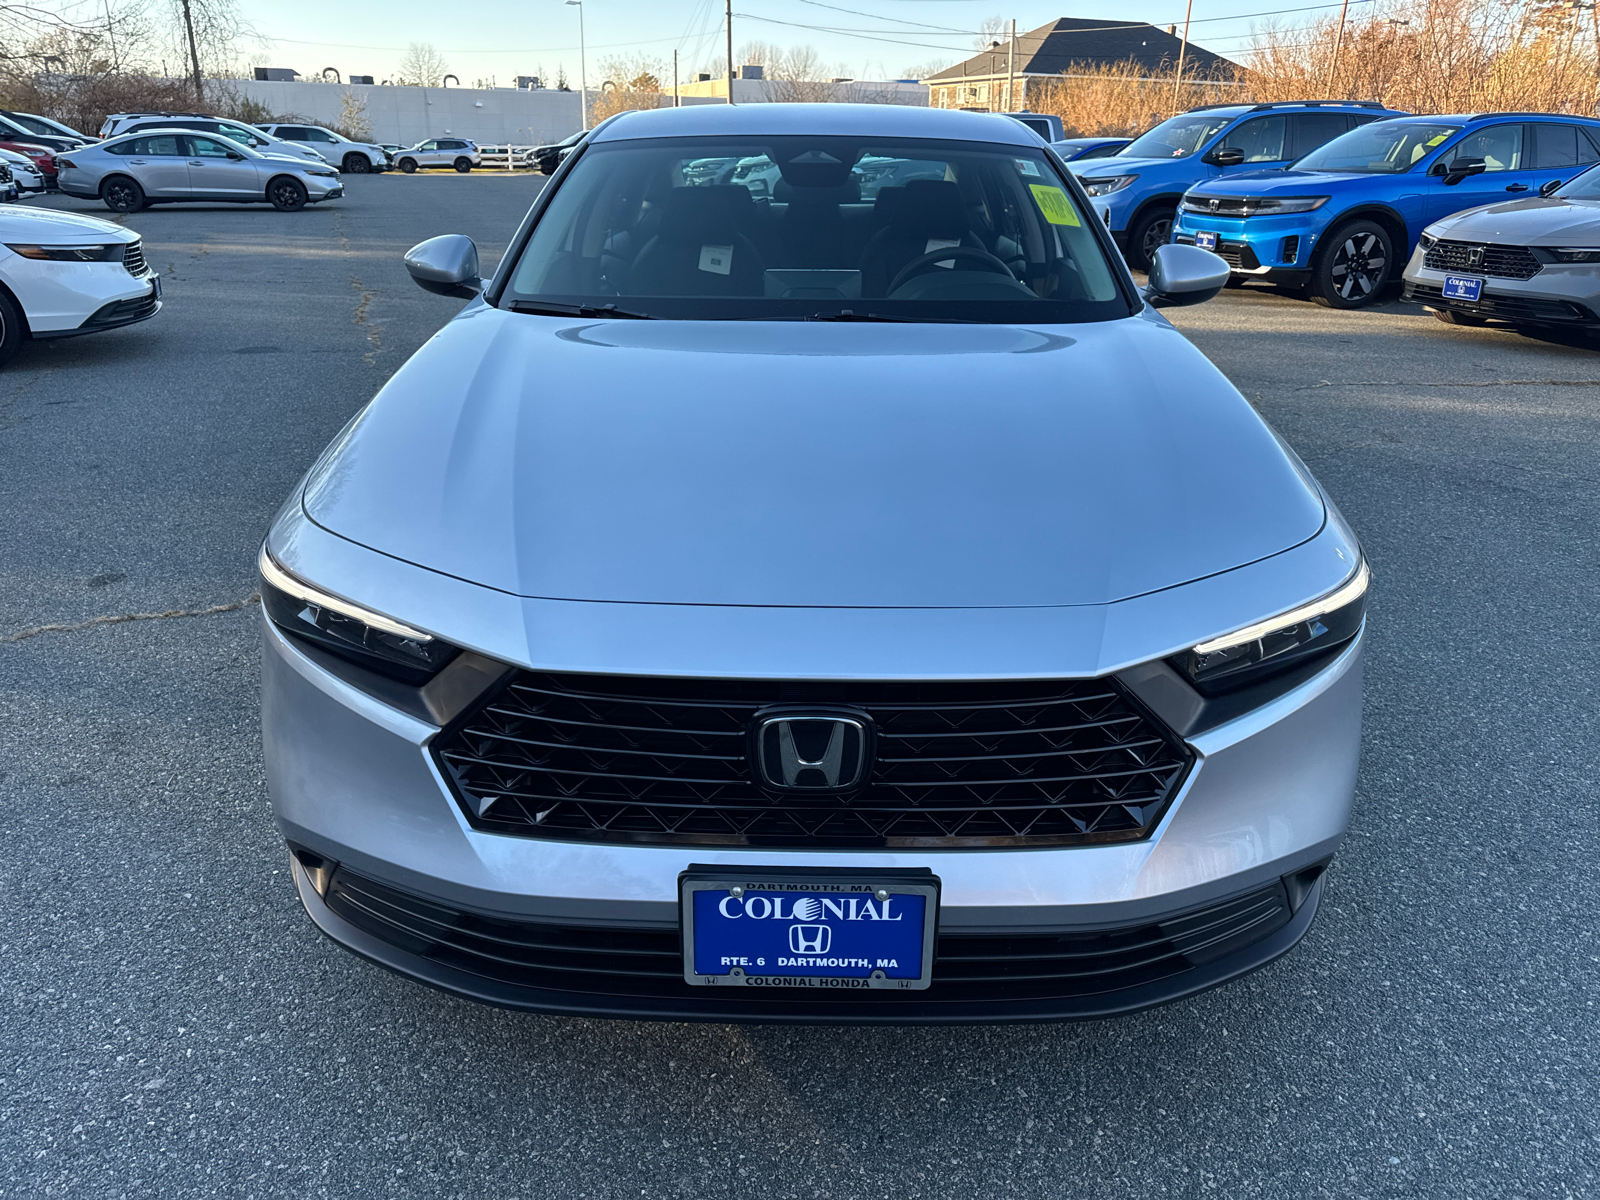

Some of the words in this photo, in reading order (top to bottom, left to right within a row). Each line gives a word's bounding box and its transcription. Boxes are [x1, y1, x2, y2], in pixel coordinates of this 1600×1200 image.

[719, 896, 903, 921] COLONIAL
[720, 956, 753, 967] RTE.
[756, 957, 766, 967] 6
[777, 957, 872, 969] DARTMOUTH,
[876, 959, 899, 968] MA
[745, 977, 816, 987] COLONIAL
[820, 978, 870, 988] HONDA
